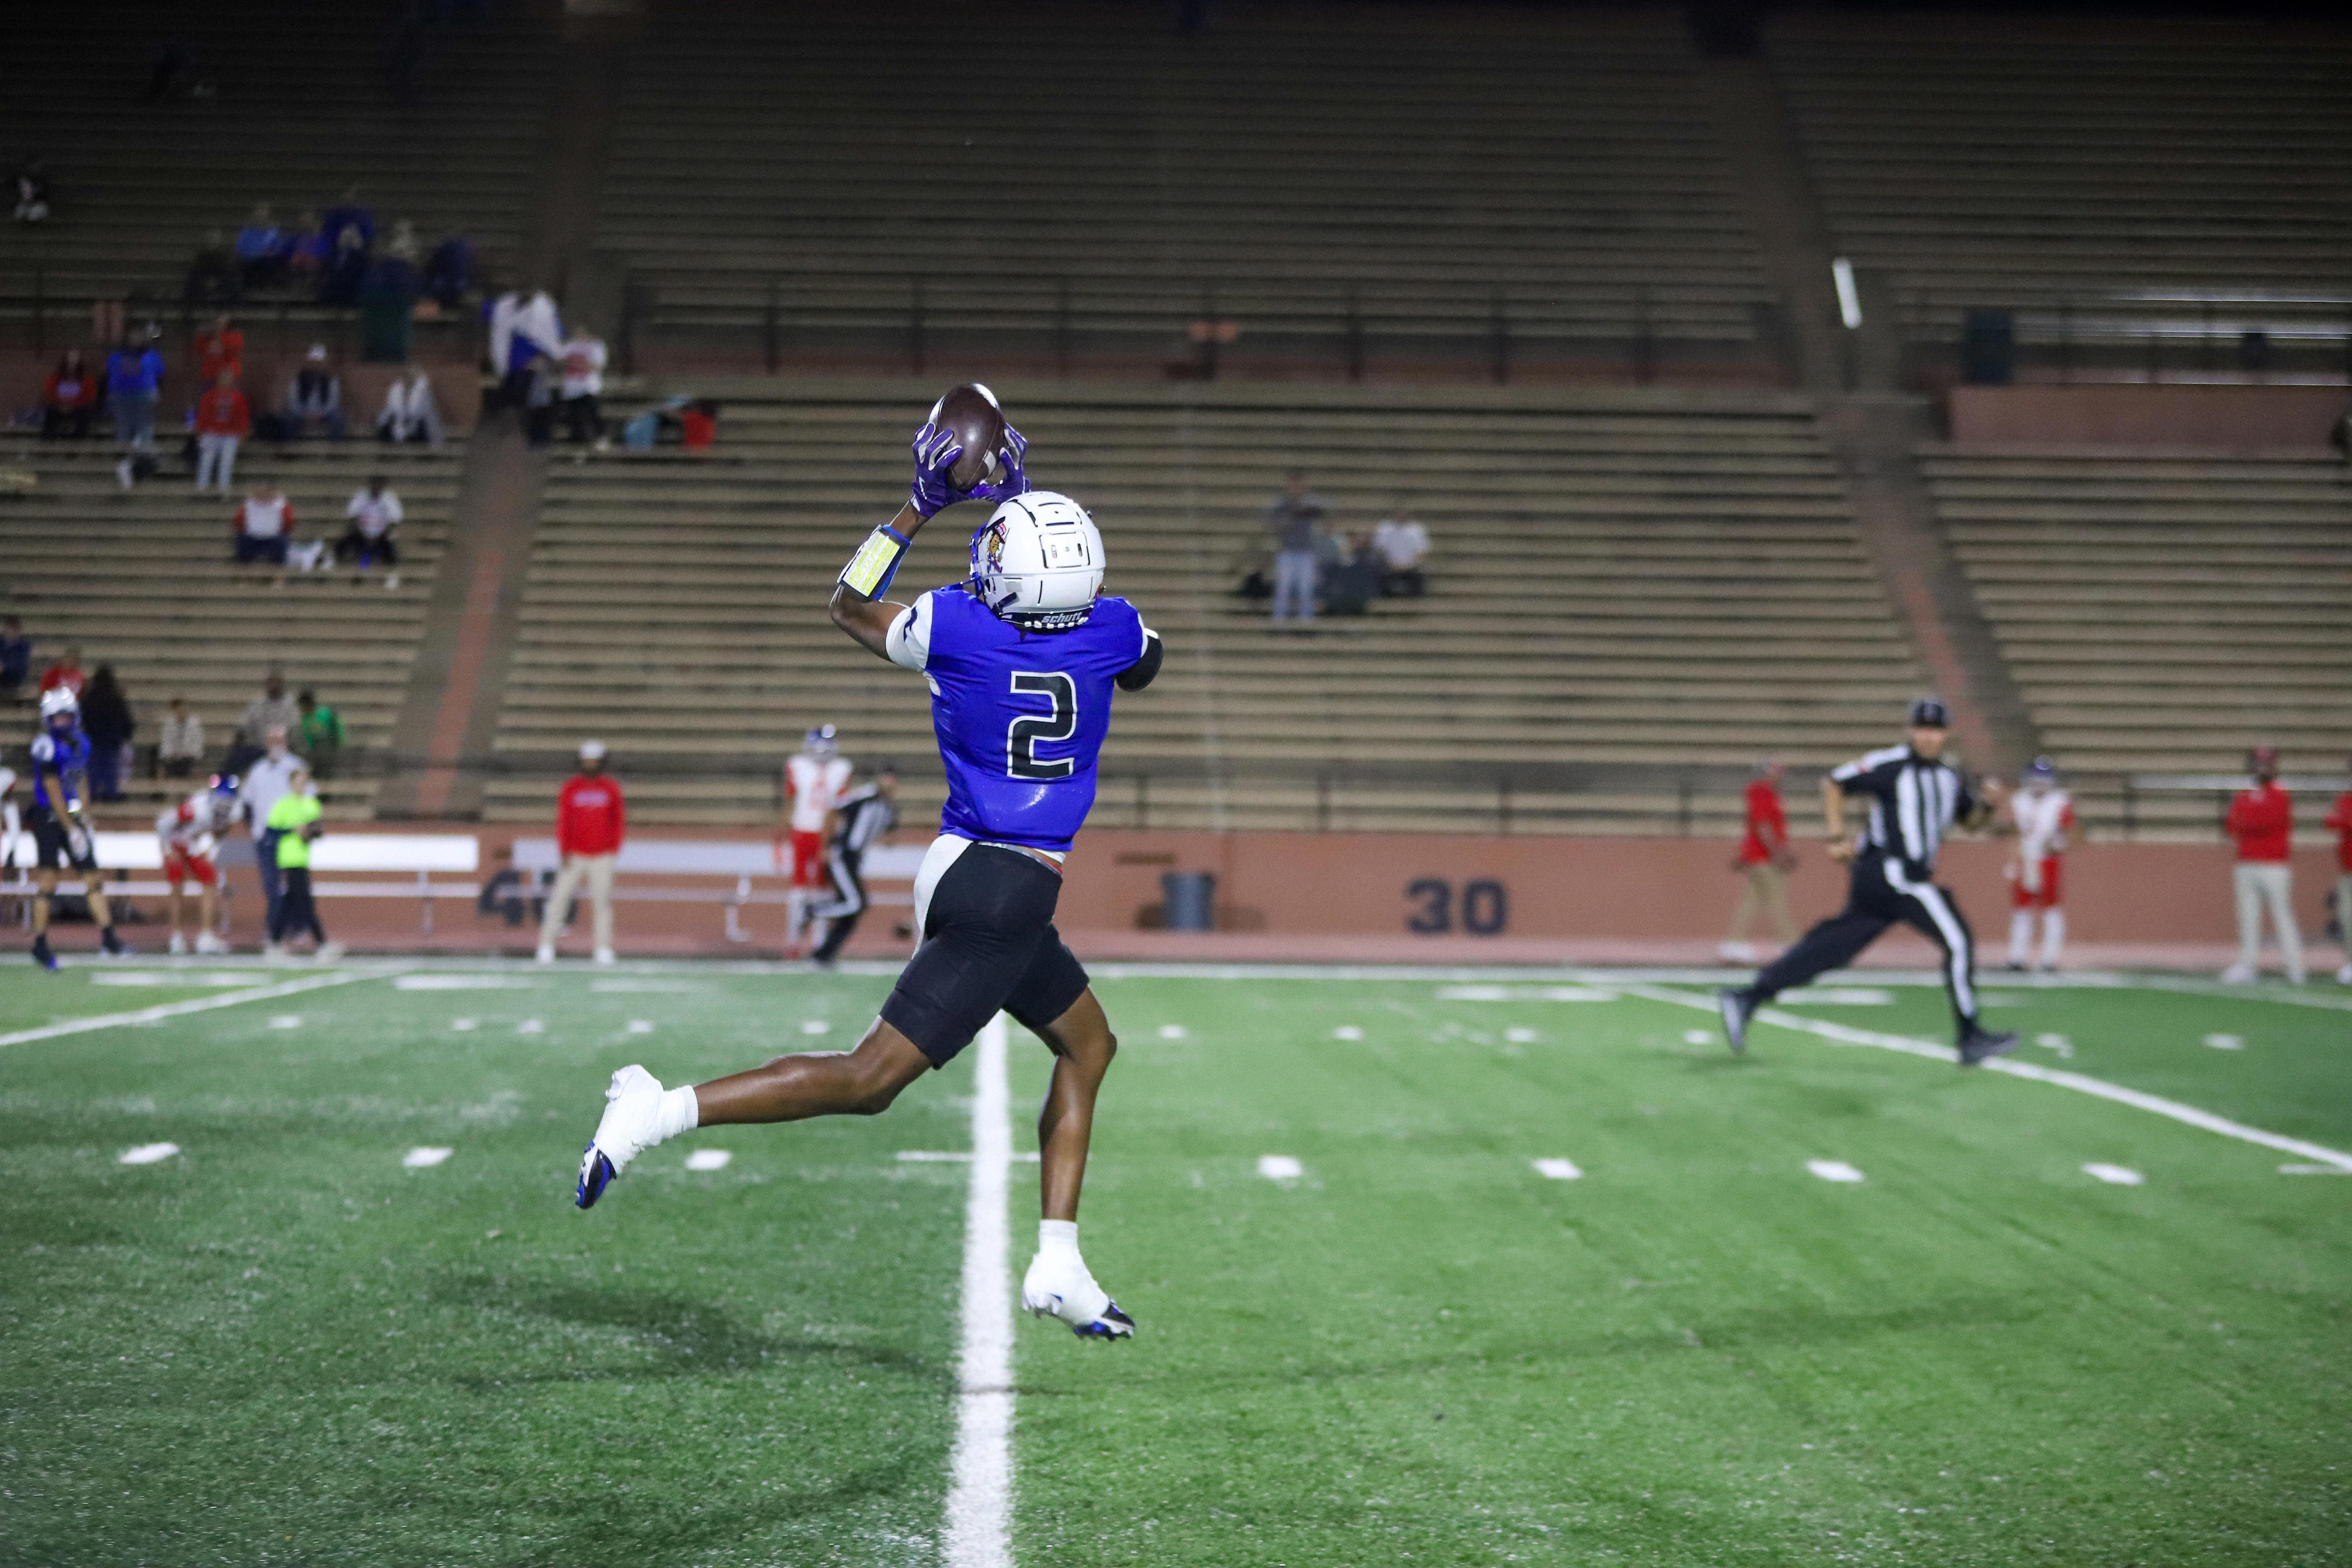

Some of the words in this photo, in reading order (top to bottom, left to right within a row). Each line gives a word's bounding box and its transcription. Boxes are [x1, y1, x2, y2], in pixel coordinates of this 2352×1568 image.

[1041, 612, 1083, 624] schutt
[1007, 671, 1078, 780] 2
[1408, 877, 1508, 937] 30
